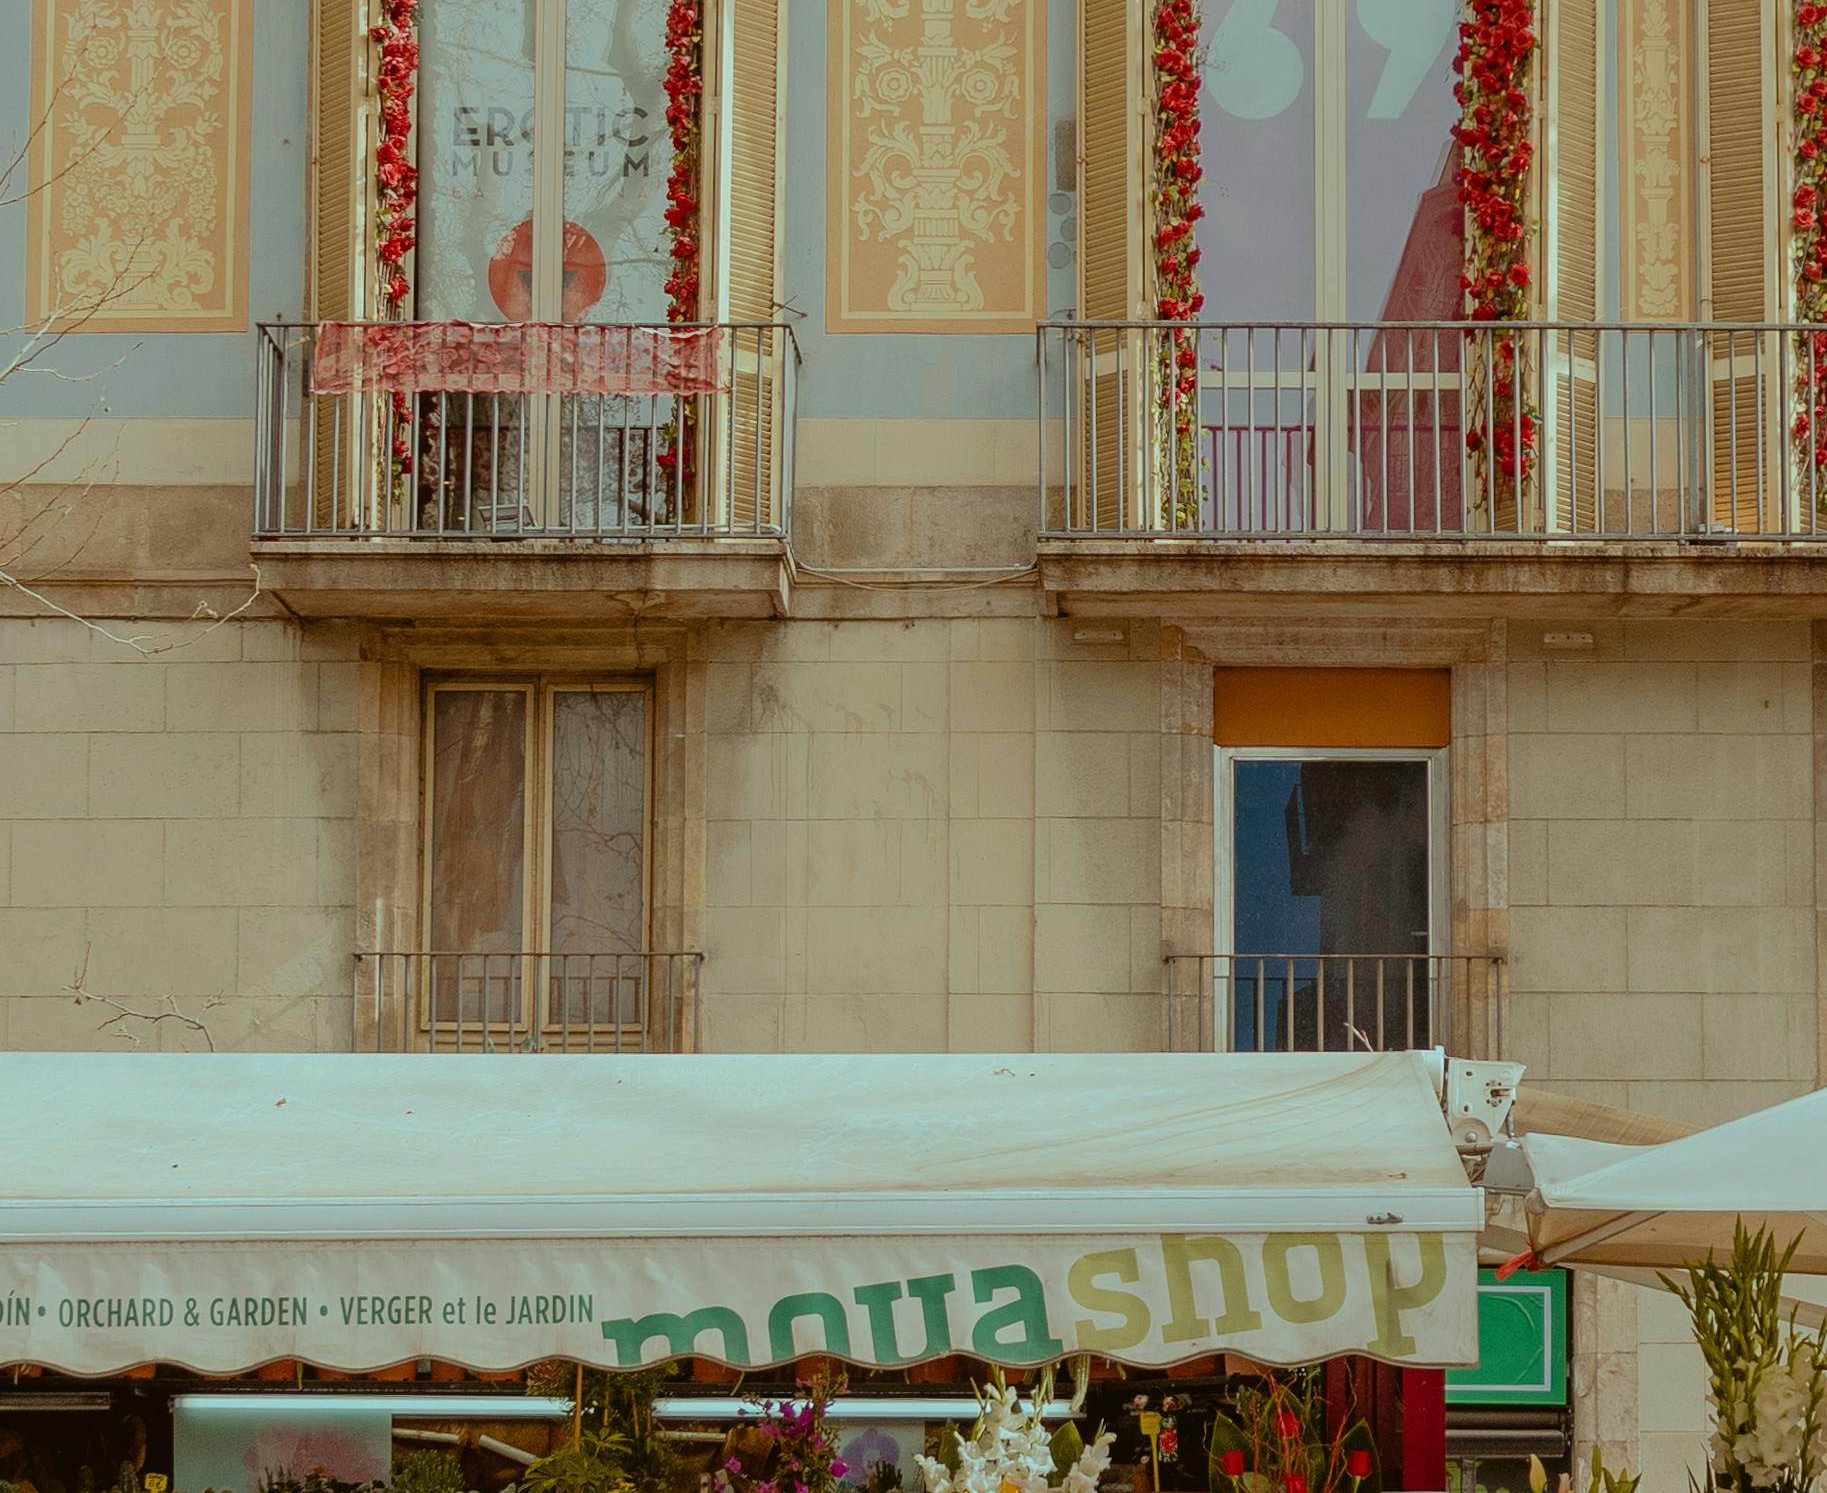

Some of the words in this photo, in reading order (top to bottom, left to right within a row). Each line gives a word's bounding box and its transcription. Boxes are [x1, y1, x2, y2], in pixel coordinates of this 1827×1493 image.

[451, 151, 648, 177] MUEUM
[0, 1290, 30, 1326] ÍN
[58, 1298, 174, 1327] ORCHARD
[184, 1298, 200, 1326] &
[210, 1296, 308, 1326] GARDEN
[340, 1296, 433, 1325] VERGER
[442, 1297, 466, 1325] et
[476, 1295, 497, 1325] le
[505, 1293, 594, 1325] JARDIN
